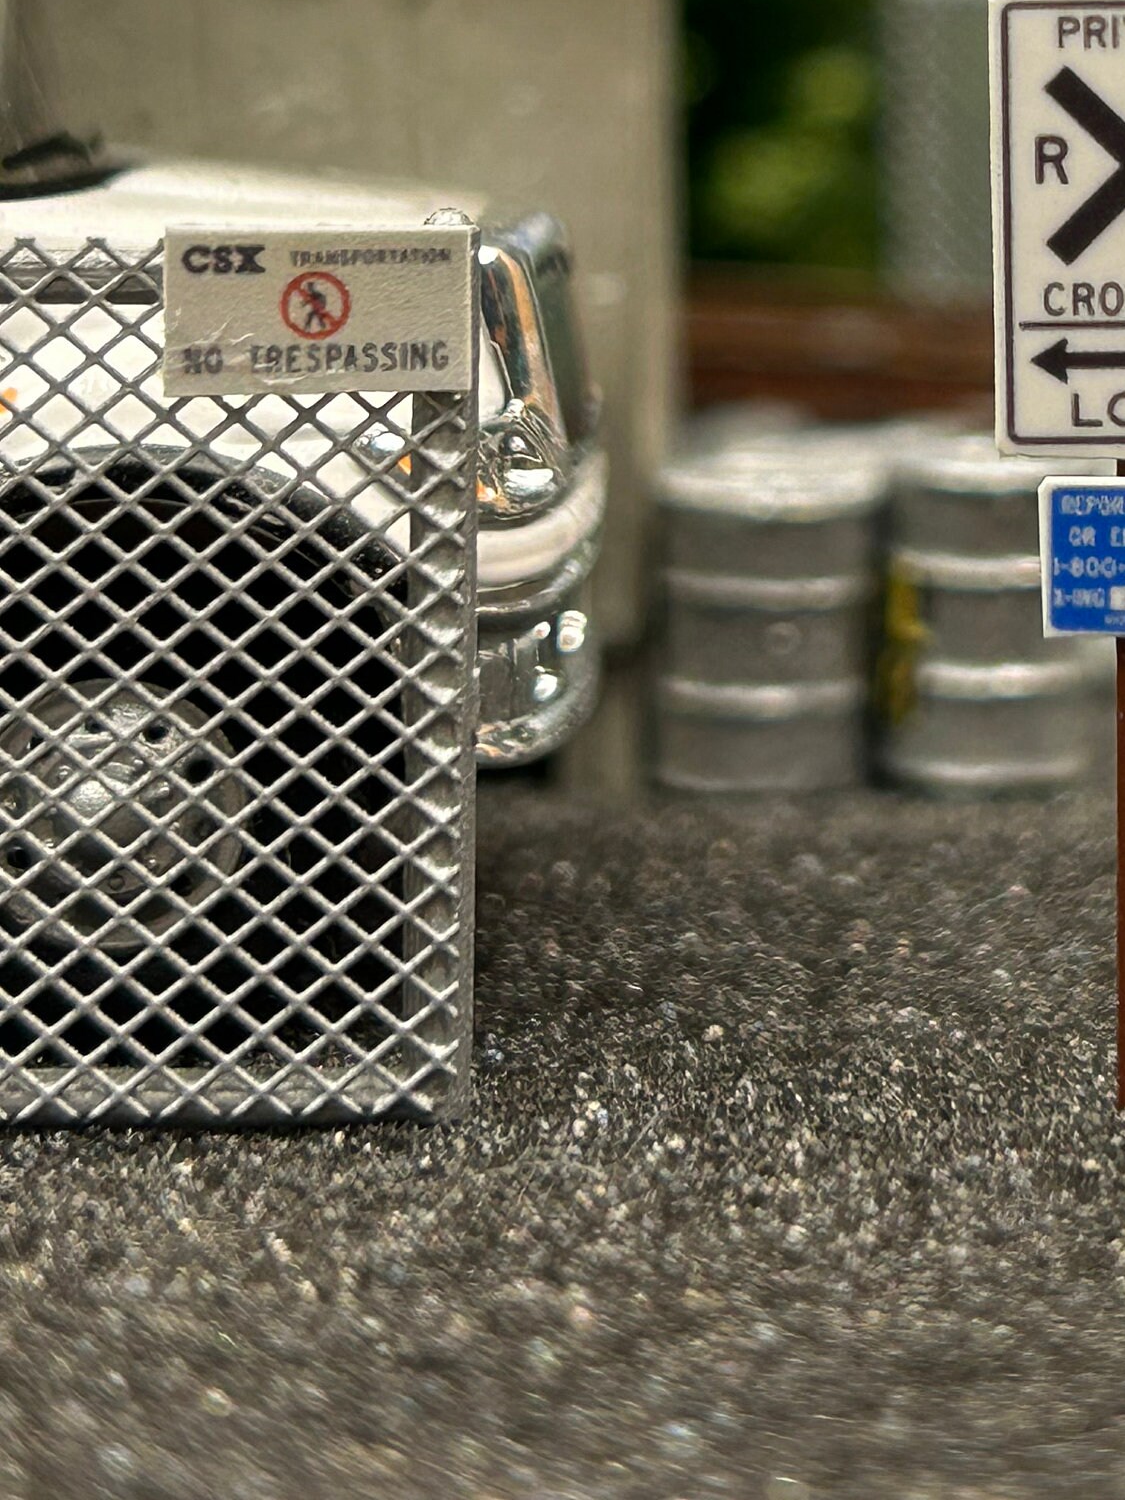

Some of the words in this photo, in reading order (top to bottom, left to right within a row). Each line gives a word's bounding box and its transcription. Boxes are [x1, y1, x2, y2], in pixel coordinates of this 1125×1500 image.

[181, 244, 266, 274] CSX
[289, 248, 451, 267] TRANSPORTATION
[183, 345, 224, 375] NO
[249, 340, 450, 373] TRESPASSING
